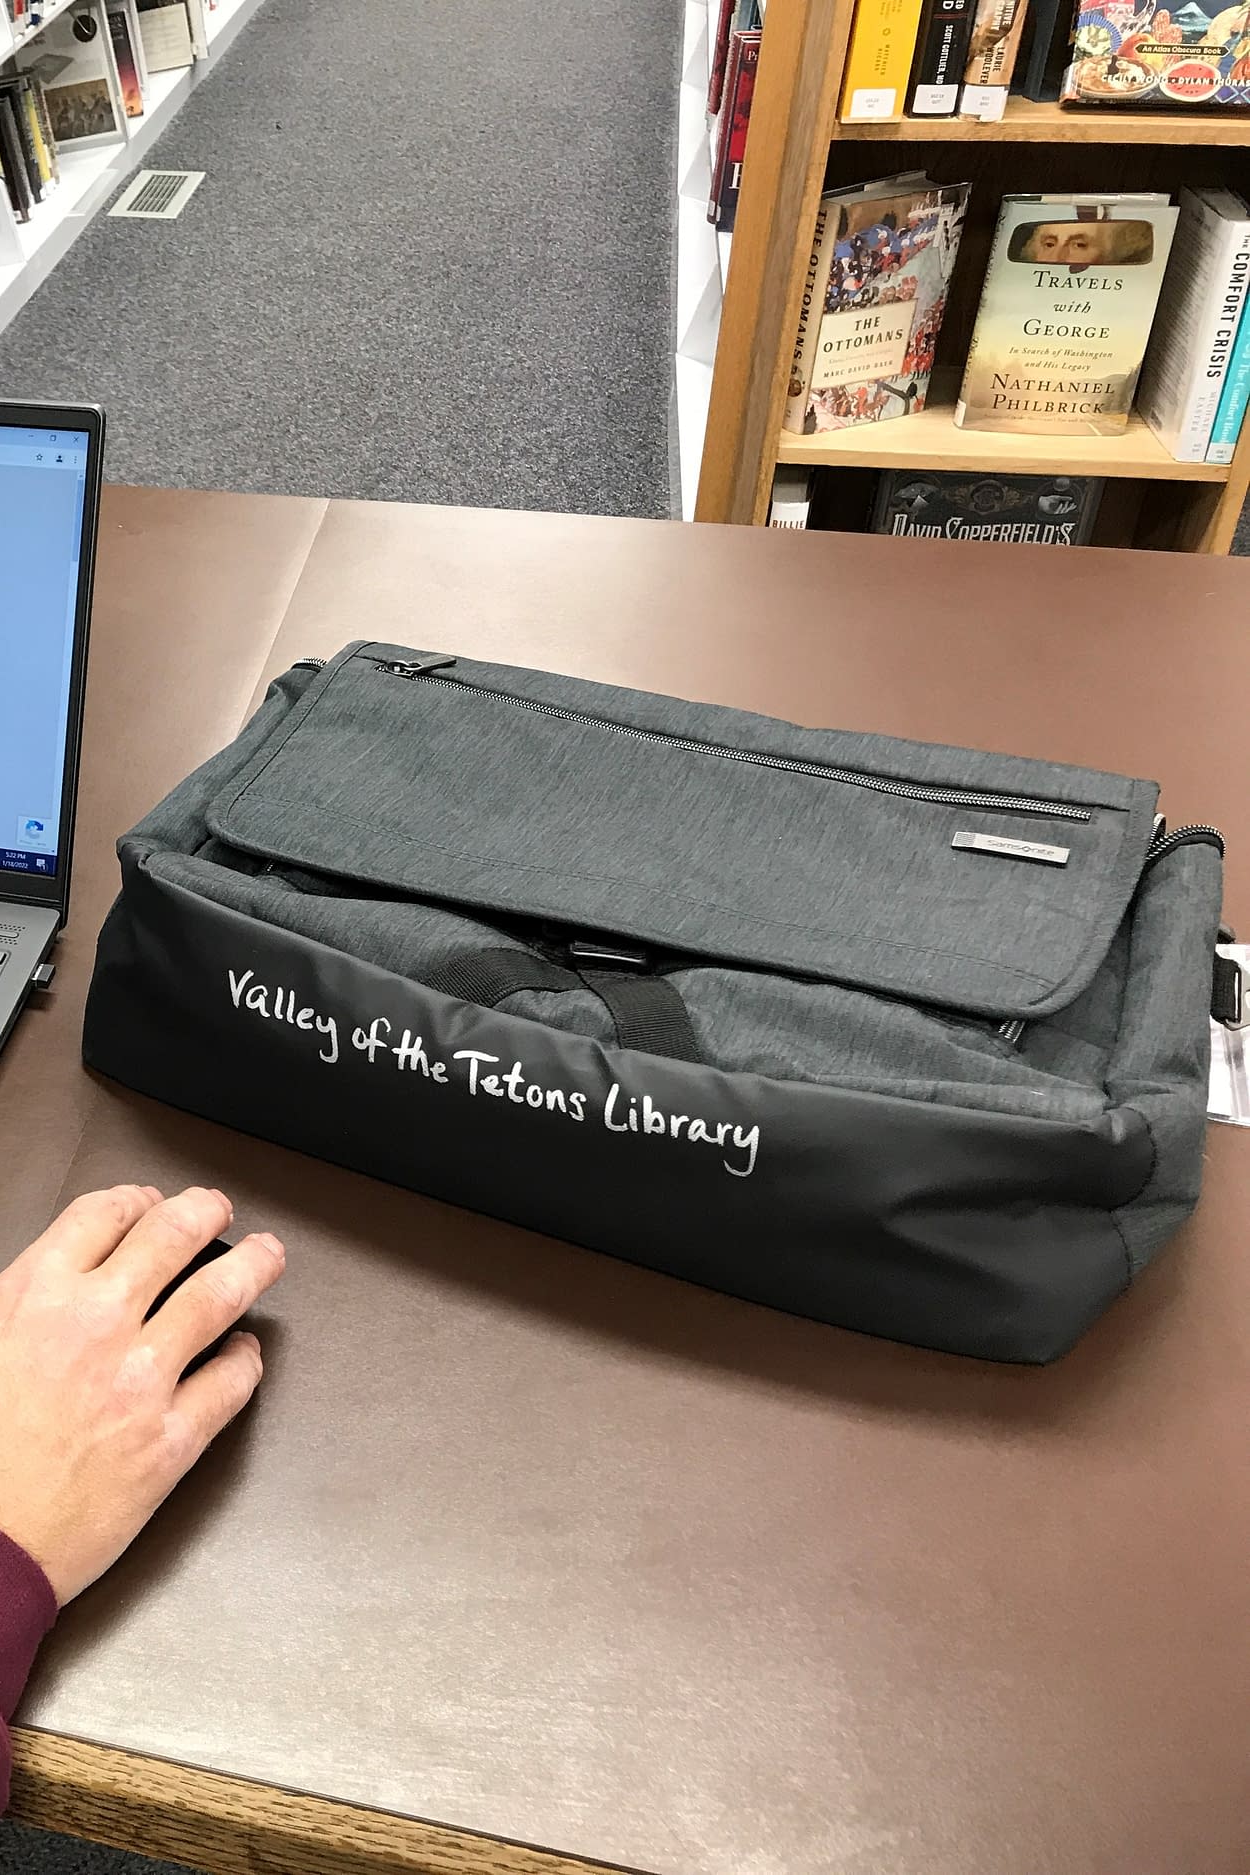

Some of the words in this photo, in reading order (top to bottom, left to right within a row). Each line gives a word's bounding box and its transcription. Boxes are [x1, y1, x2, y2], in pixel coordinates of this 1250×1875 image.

[943, 25, 954, 43] SCOTT
[980, 47, 995, 84] WOOLEVER
[993, 47, 1005, 72] LAURIE
[1101, 74, 1134, 83] CECILY
[1136, 75, 1168, 85] WONG
[1178, 77, 1212, 86] DYLAN
[813, 210, 827, 247] THE
[1220, 253, 1250, 323] COMFORT
[793, 255, 819, 361] OTTOMANS
[1054, 301, 1092, 314] with
[854, 316, 882, 331] THE
[822, 328, 904, 353] OTTOMANS
[1021, 347, 1050, 356] Search
[1051, 348, 1062, 357] of
[1063, 349, 1113, 360] Washington
[1207, 329, 1231, 378] CRISIS
[823, 368, 845, 379] MARC
[847, 363, 871, 374] DAVID
[1024, 360, 1041, 368] and
[1043, 362, 1059, 370] His
[1061, 363, 1091, 373] Legacy
[772, 519, 805, 529] BILLIE
[892, 514, 942, 539] DAVID
[228, 968, 340, 1063] Valley
[351, 1017, 391, 1062] of
[393, 1029, 450, 1084] the
[452, 1050, 588, 1122] Tetons
[604, 1083, 761, 1178] Library
